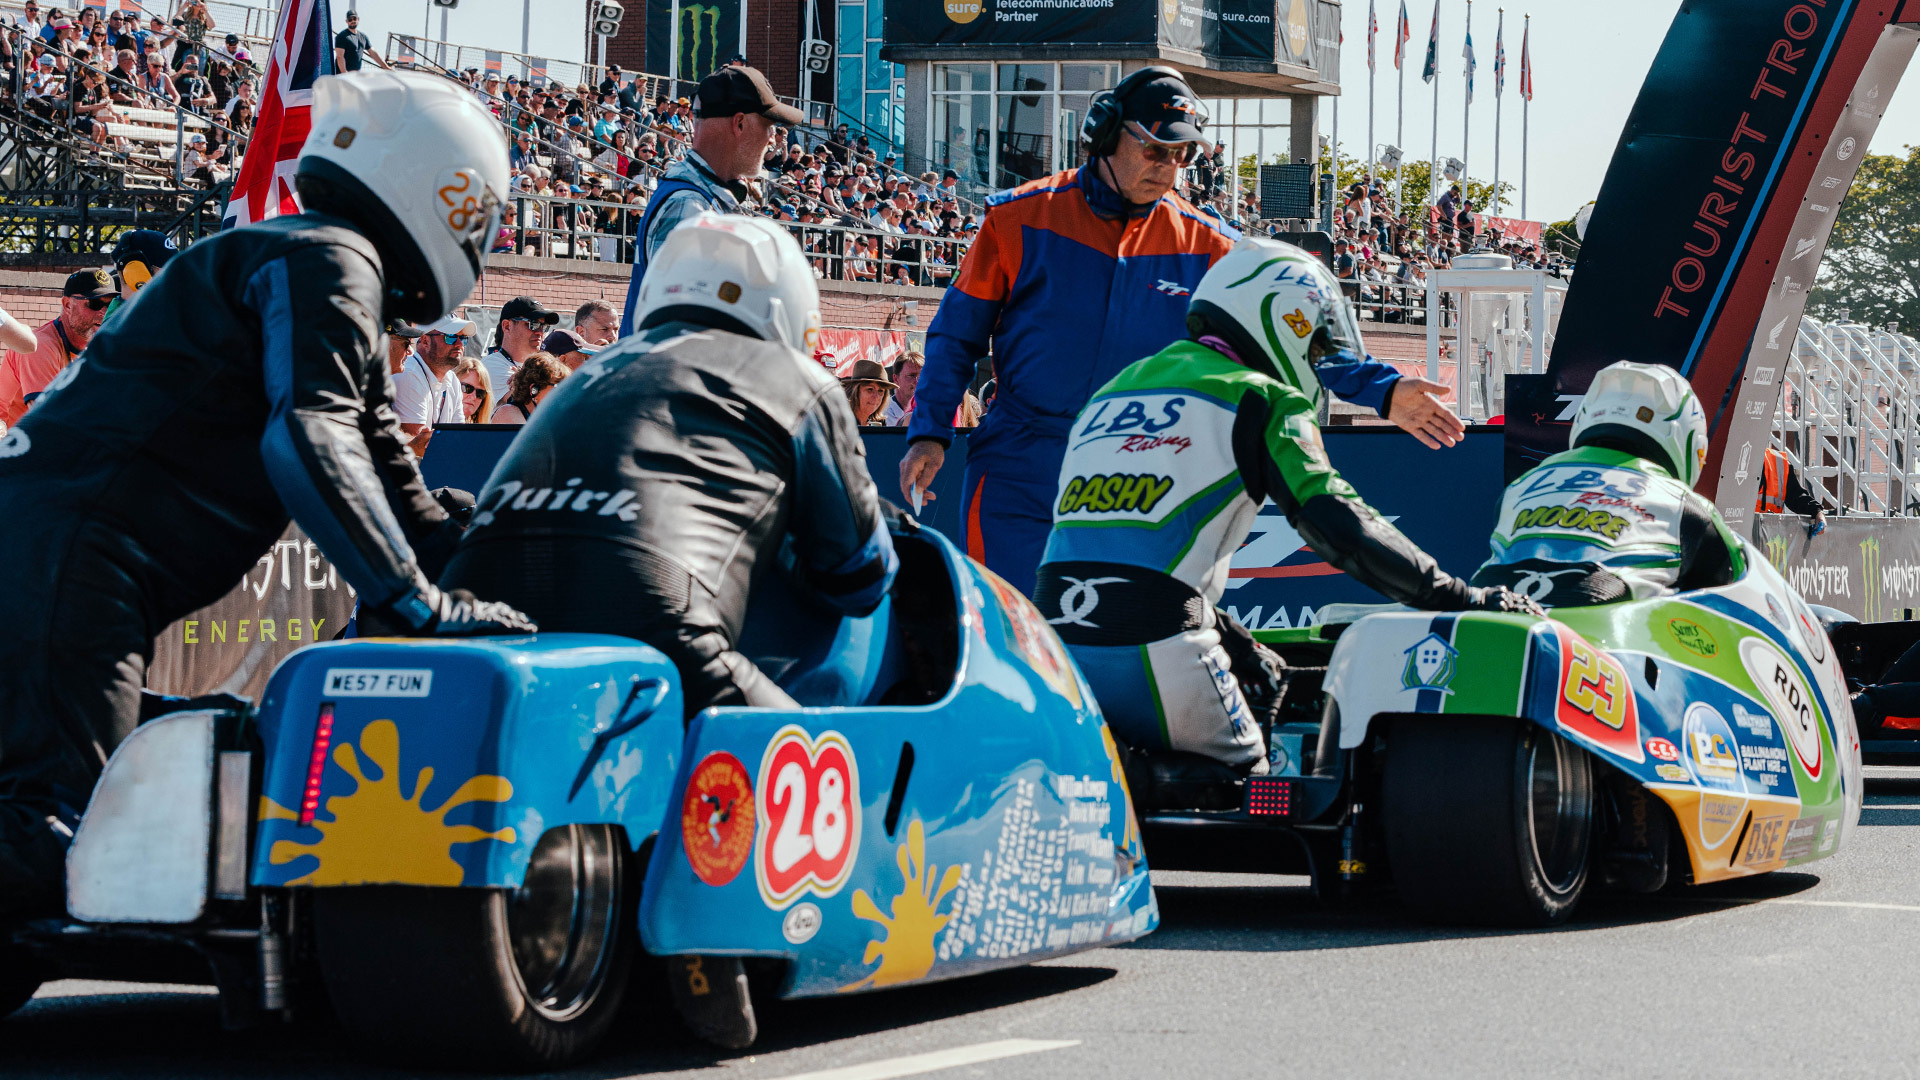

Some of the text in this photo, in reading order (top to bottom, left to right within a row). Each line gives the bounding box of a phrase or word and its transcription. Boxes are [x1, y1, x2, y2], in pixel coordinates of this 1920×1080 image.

[995, 11, 1039, 22] Partner
[1179, 15, 1195, 28] Partner
[1222, 12, 1270, 24] sure.com
[437, 171, 477, 231] 28
[1653, 111, 1768, 319] TOURIST
[1156, 279, 1190, 296] TT
[1282, 308, 1312, 339] 23
[1080, 397, 1186, 437] LBS
[1115, 432, 1192, 455] Racing
[1058, 473, 1174, 515] GASHY
[1519, 469, 1649, 498] LBS
[1511, 505, 1631, 541] MOORE
[1570, 492, 1656, 523] Racing
[1789, 558, 1851, 600] MONSTER
[184, 618, 326, 644] ENERGY
[332, 675, 423, 691] WE57 FUN
[1564, 638, 1627, 732] 23
[1773, 663, 1811, 732] RDC
[772, 761, 847, 873] 28
[1745, 820, 1783, 863] DSE
